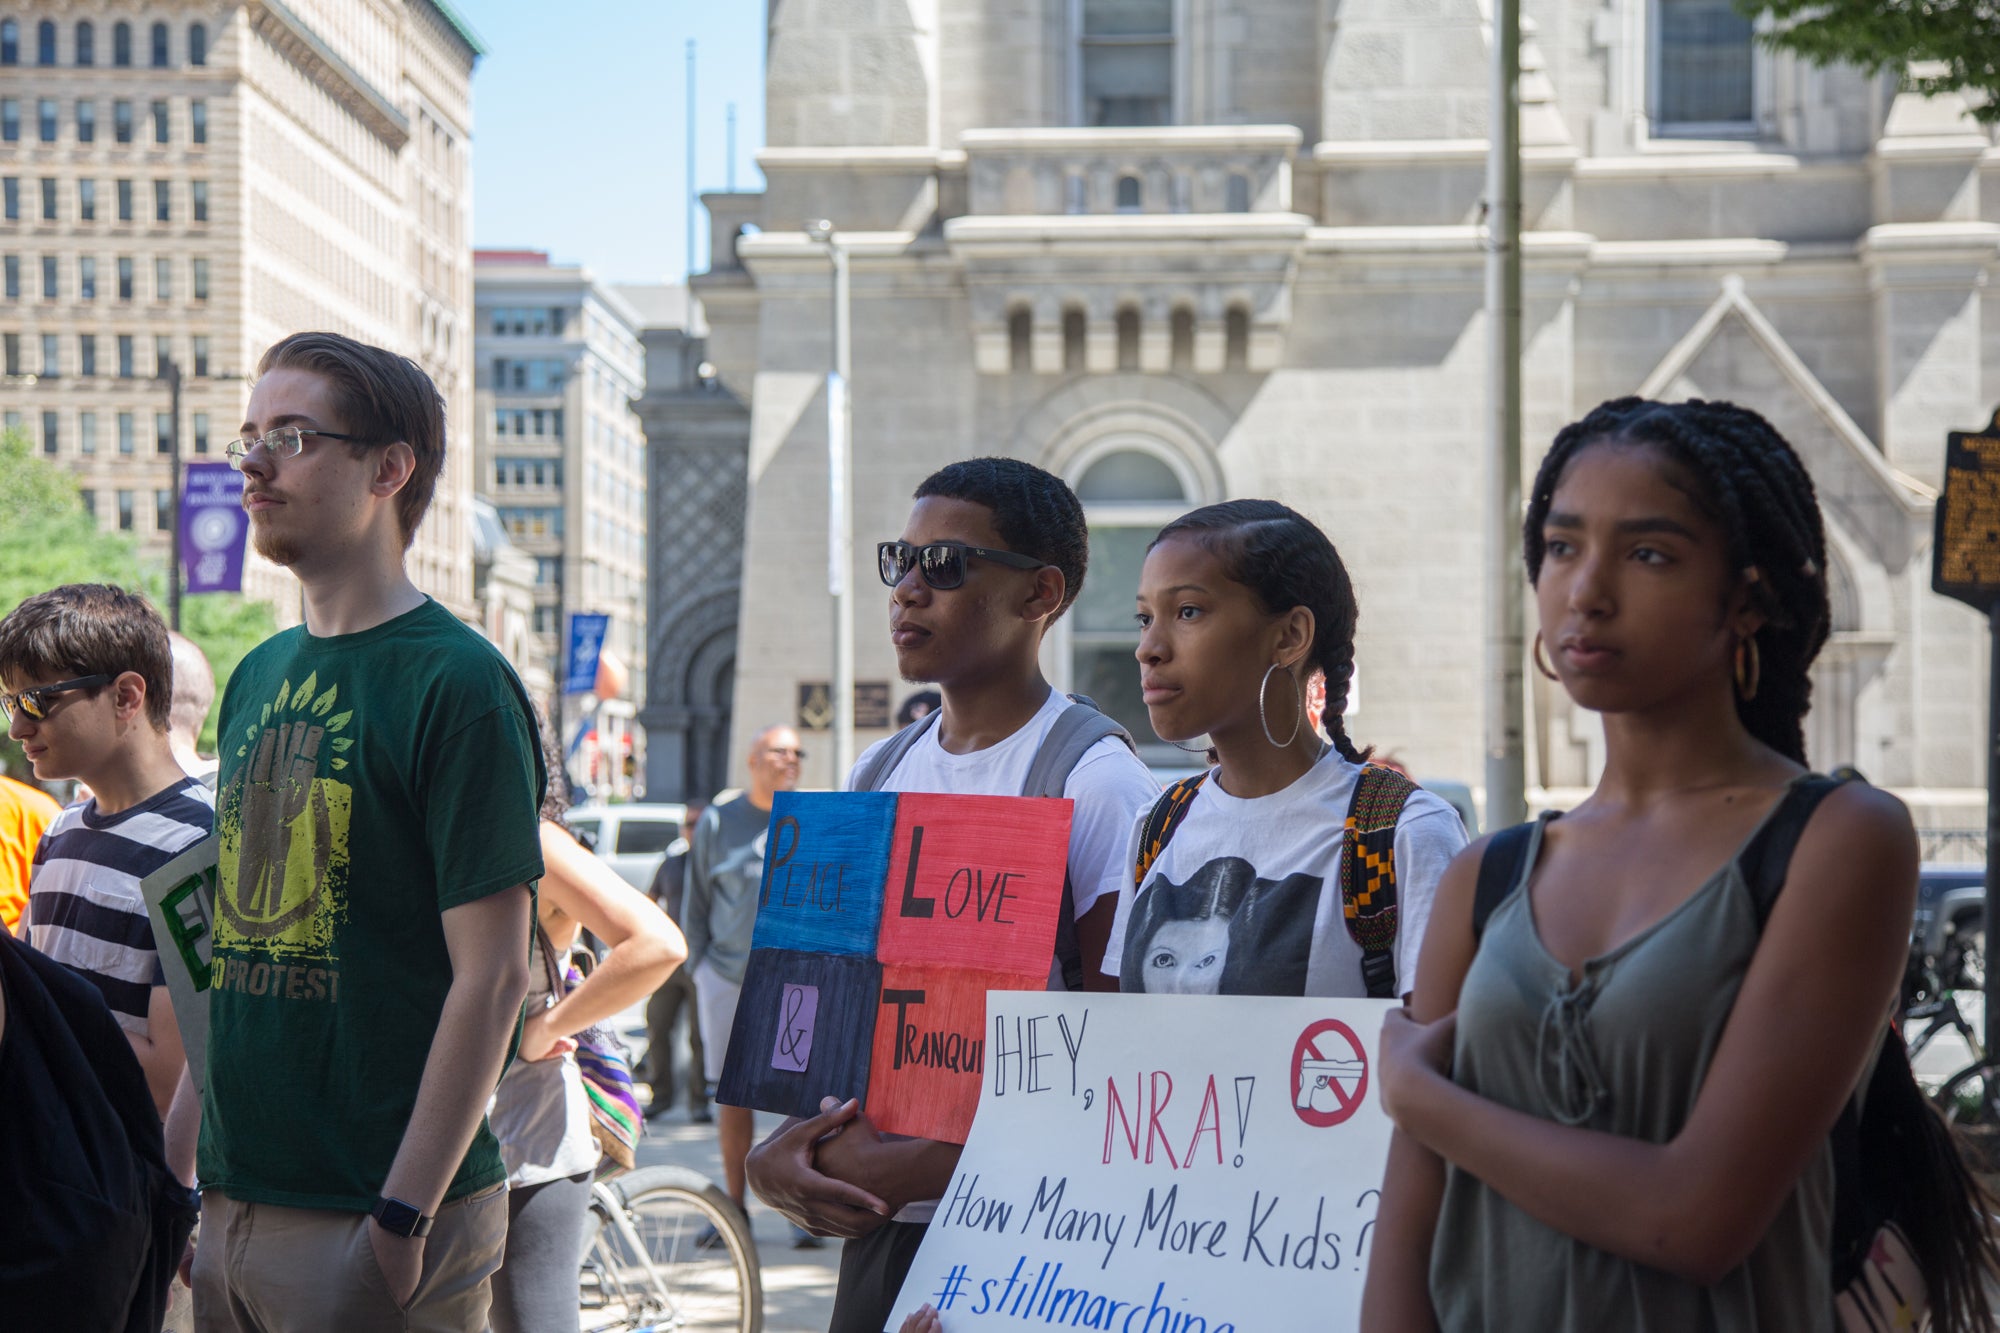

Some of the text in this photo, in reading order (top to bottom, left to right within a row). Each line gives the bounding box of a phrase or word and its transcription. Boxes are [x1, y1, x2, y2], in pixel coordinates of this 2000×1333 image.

[763, 816, 1026, 924] PEACE LOVE
[780, 988, 807, 1067] &
[994, 1008, 1256, 1171] HEY, NRA!
[942, 1173, 1381, 1272] How Many More Kids?
[932, 1256, 1236, 1333] #stillmarchin
